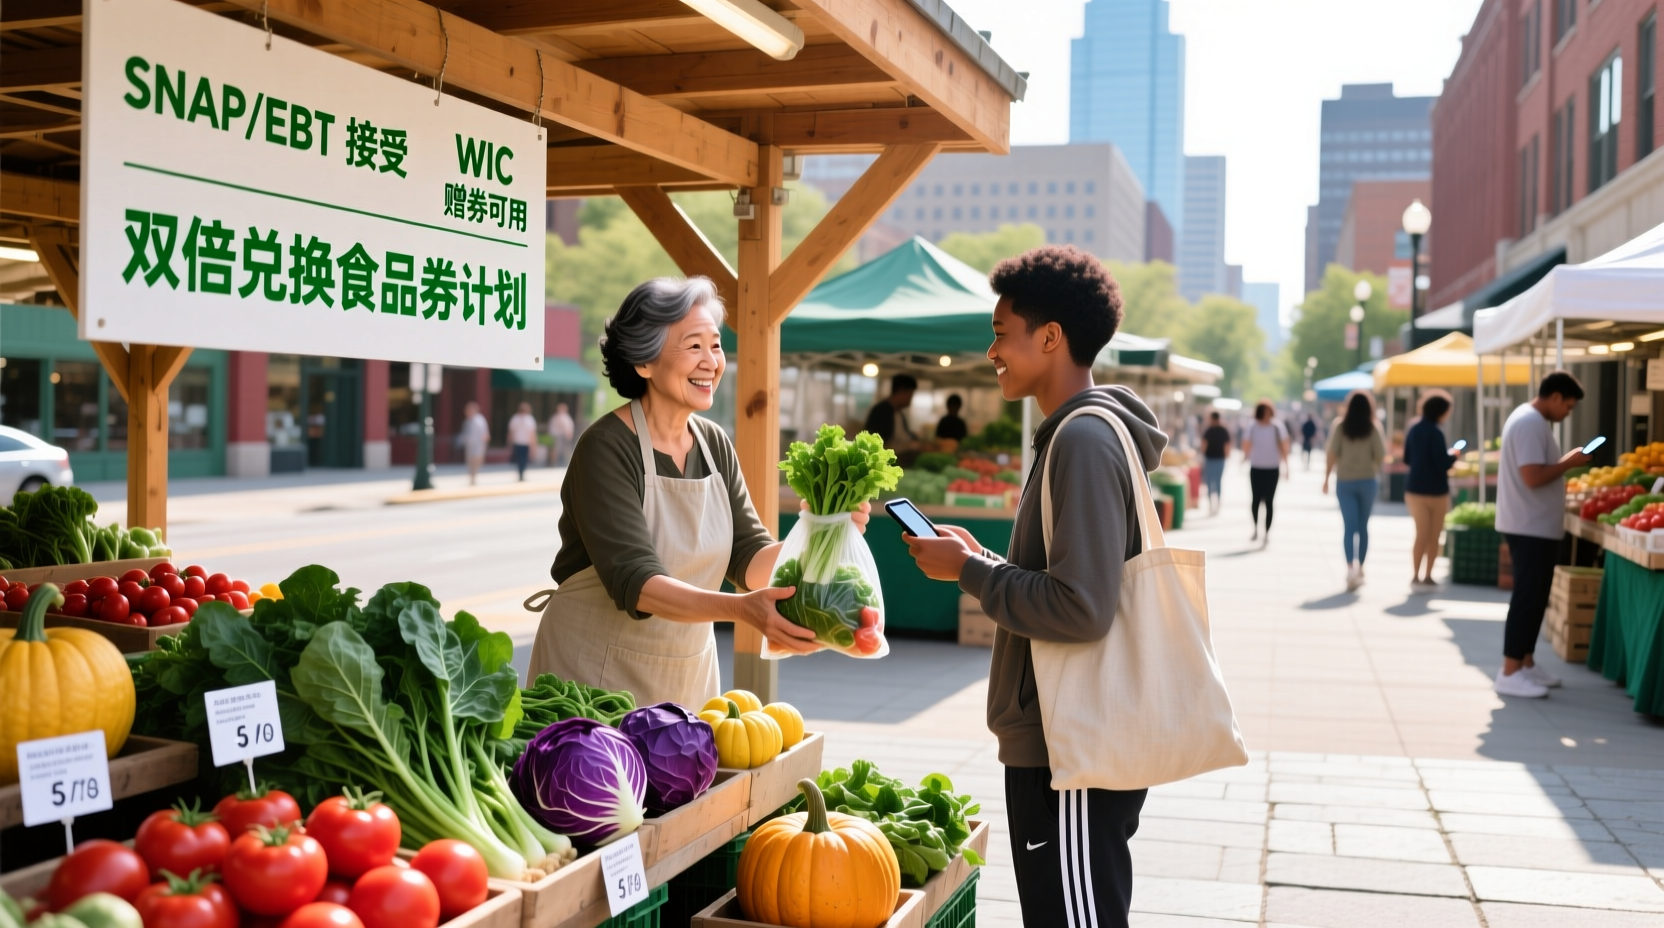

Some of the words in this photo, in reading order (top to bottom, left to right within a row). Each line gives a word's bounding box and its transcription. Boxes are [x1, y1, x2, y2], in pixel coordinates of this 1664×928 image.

[123, 56, 336, 156] SNAP/EBT
[346, 116, 408, 179] 接受
[455, 133, 514, 186] WIC
[443, 182, 528, 233] 赠券可用
[122, 208, 527, 330] 双倍兑换食品券计划
